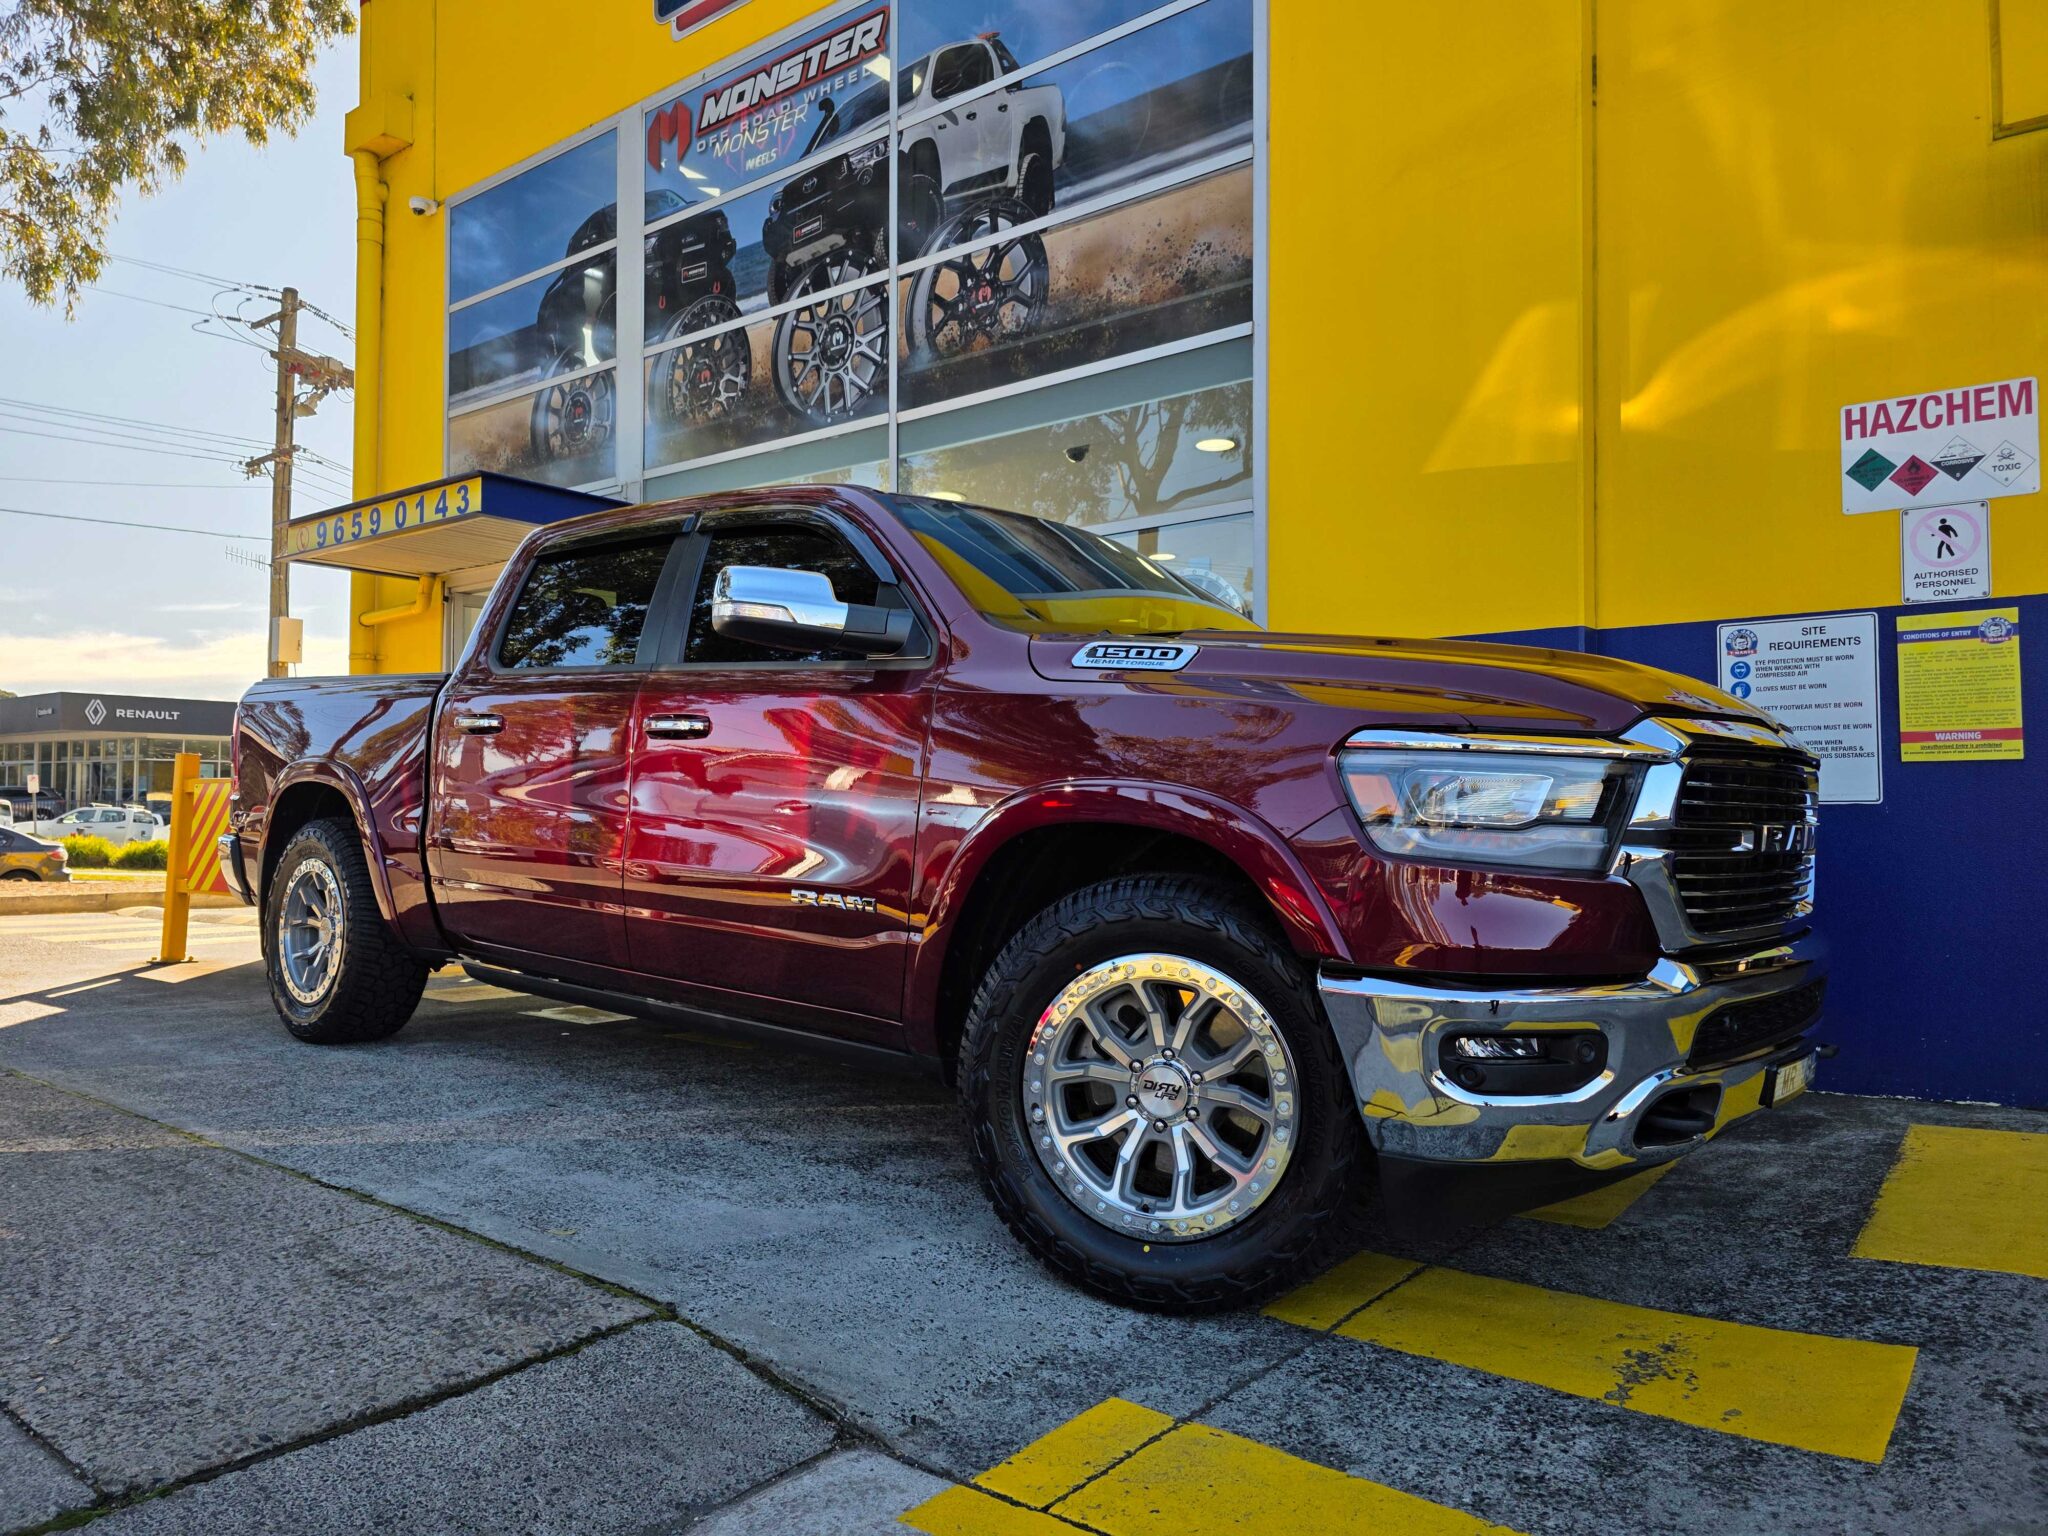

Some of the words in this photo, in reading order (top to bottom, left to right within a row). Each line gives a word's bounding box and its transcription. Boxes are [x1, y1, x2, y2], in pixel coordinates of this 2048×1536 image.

[700, 13, 884, 129] MONSTER
[697, 129, 728, 152] OFF
[741, 101, 790, 132] ROAD
[713, 103, 809, 158] MONSTER
[1844, 380, 2033, 441] HAZCHEM
[1941, 458, 1975, 466] CORROSIVE
[1992, 462, 2021, 472] TOXIC
[316, 507, 381, 548] 9659
[394, 484, 470, 529] 0143
[1913, 567, 1979, 580] AUTHORISED
[1915, 577, 1976, 589] PERSONNEL
[1933, 588, 1958, 597] ONLY
[1802, 625, 1826, 636] SITE
[1903, 632, 1939, 640] CONDITIONS
[1769, 636, 1862, 651] REQUIREMENTS
[1095, 647, 1177, 659] 1500
[1767, 657, 1805, 665] PROTECTION
[1755, 671, 1796, 679] COMPRESSED
[1780, 703, 1813, 711] FOOTWEAR
[116, 708, 180, 720] RENAULT
[1935, 731, 1982, 741] WARNING
[790, 889, 877, 914] RAM
[1143, 1079, 1182, 1094] DIRTY
[1154, 1091, 1178, 1101] LIFE
